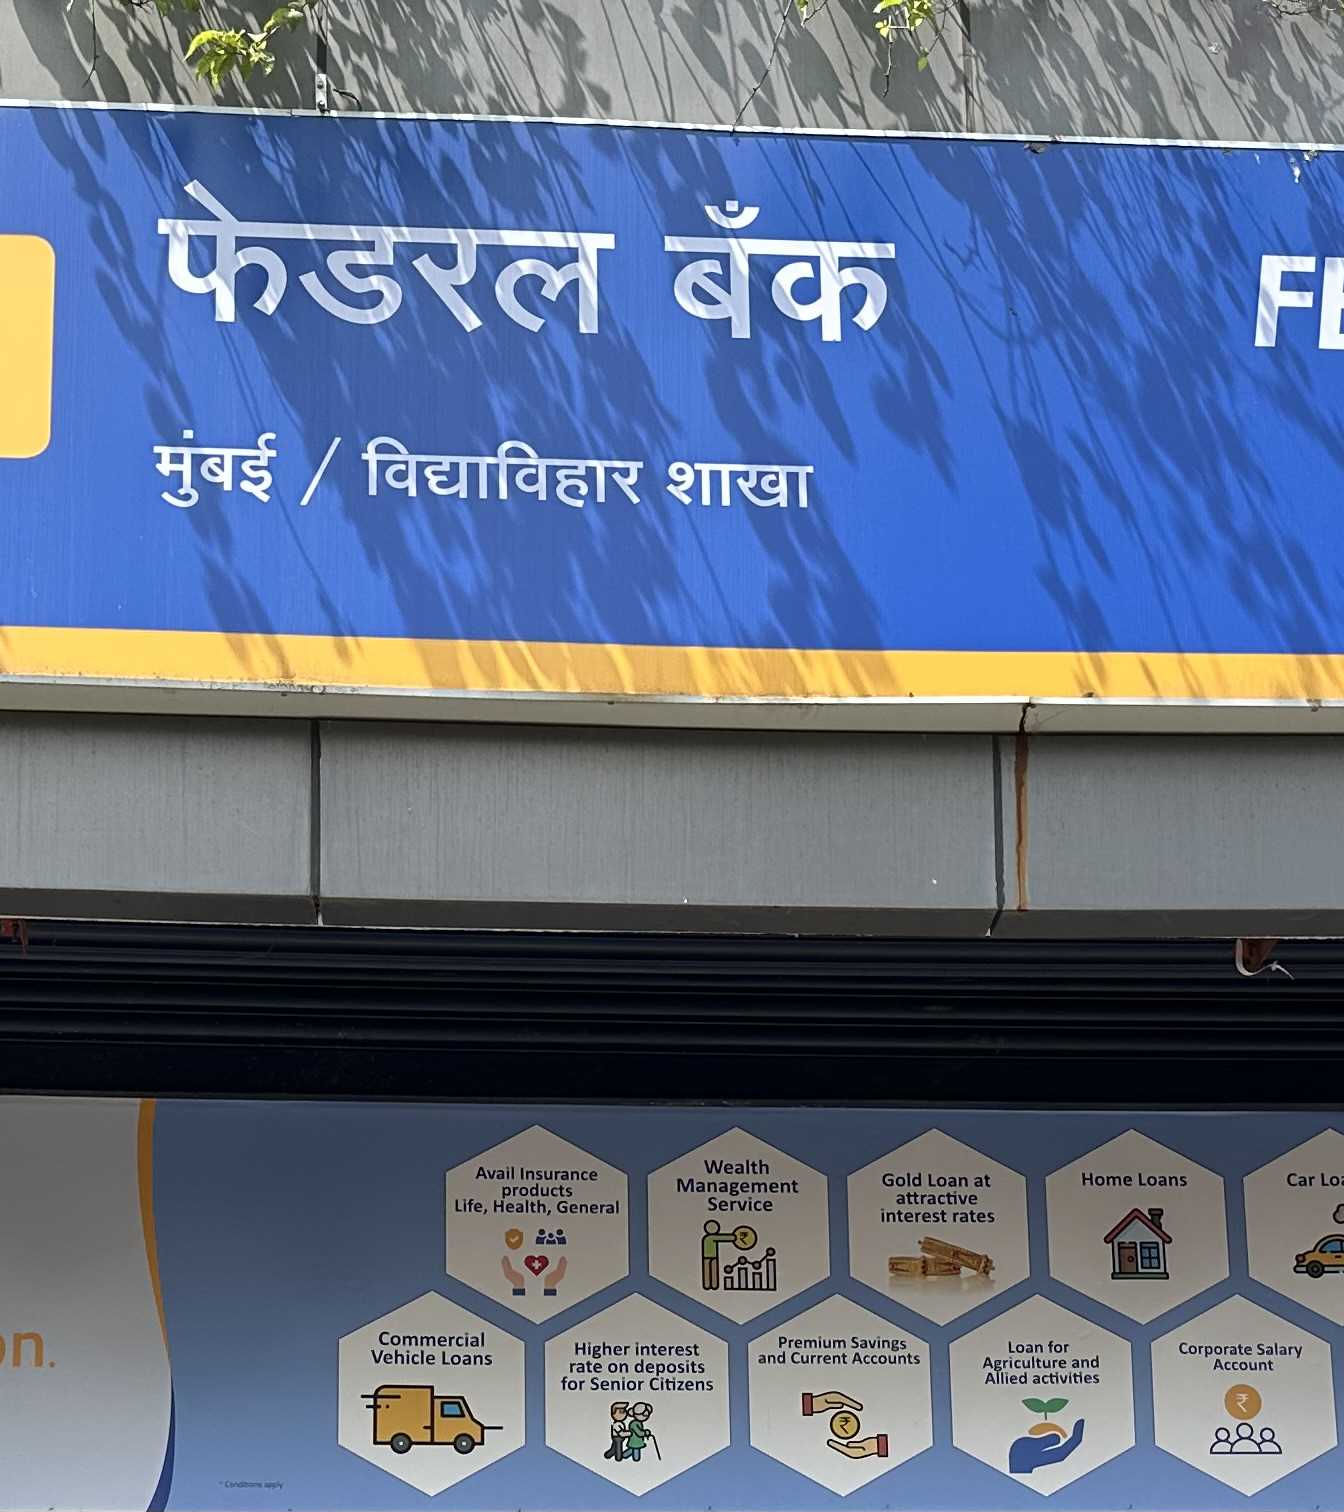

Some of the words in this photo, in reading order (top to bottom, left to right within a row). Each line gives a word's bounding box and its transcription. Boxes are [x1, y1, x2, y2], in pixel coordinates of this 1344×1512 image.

[158, 179, 615, 334] फेडरल
[664, 201, 895, 342] बँक
[153, 430, 278, 508] मुंबई
[300, 437, 340, 506] /
[361, 436, 642, 508] विद्याविहार
[667, 461, 813, 509] शाखा
[704, 1160, 769, 1175] Wealth
[676, 1178, 798, 1196] Management
[882, 1172, 920, 1188] Gold
[928, 1173, 969, 1189] Loan
[974, 1174, 990, 1188] at
[1082, 1173, 1132, 1187] Home
[1138, 1173, 1187, 1187] Loans
[1287, 1173, 1314, 1187] Car
[708, 1197, 773, 1212] Service
[896, 1191, 977, 1206] attractive
[880, 1208, 947, 1223] interest
[953, 1210, 995, 1224] rates
[378, 1331, 485, 1348] Commercial
[371, 1350, 437, 1366] Vehicle
[441, 1351, 493, 1367] Loans
[1179, 1342, 1252, 1359] Corporate
[1257, 1343, 1302, 1359] Salary
[1213, 1358, 1273, 1372] Account
